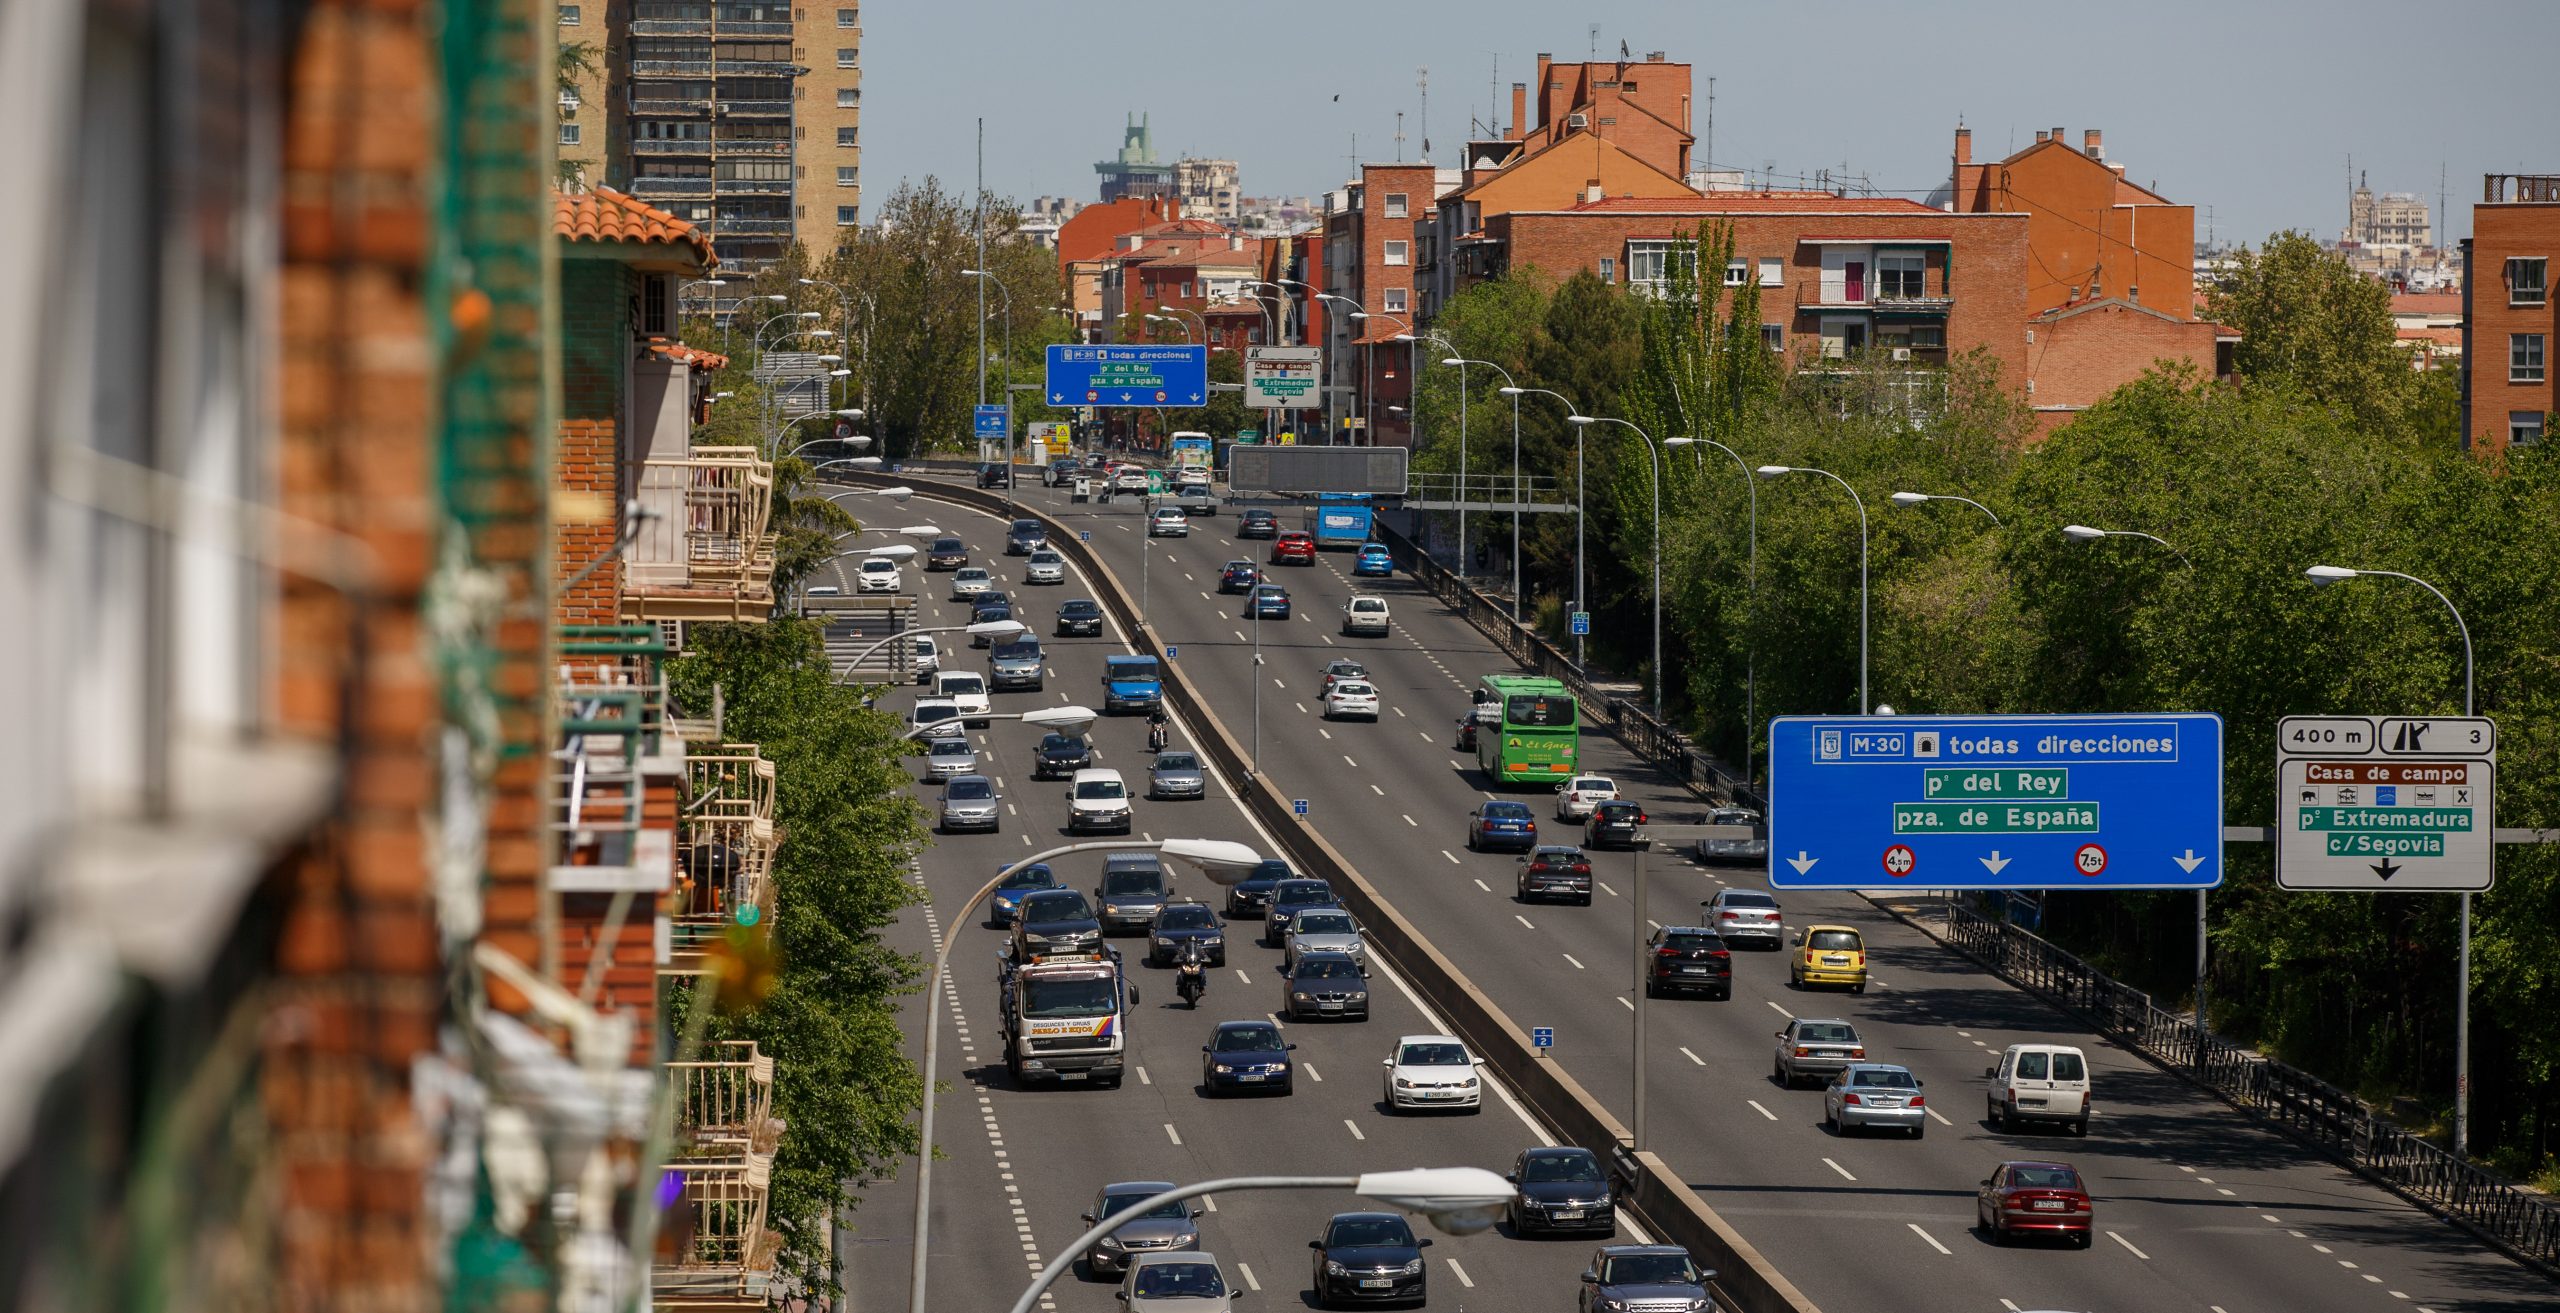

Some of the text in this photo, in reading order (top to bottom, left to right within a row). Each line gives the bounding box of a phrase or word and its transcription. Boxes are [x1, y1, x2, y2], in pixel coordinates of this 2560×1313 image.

[1134, 365, 1150, 373] Rey
[1130, 376, 1162, 386] España
[1854, 734, 2173, 754] M-30 todas direcciones
[2292, 730, 2362, 743] 400 m
[2470, 730, 2481, 744] 3
[2308, 764, 2465, 784] Casa de campo
[1963, 772, 2000, 792] del
[2018, 773, 2062, 794] Rey
[1898, 806, 2094, 830] pza. de España
[2333, 810, 2470, 827] Extremadura
[2330, 836, 2441, 856] c/Segovia
[1540, 1038, 1546, 1046] 2
